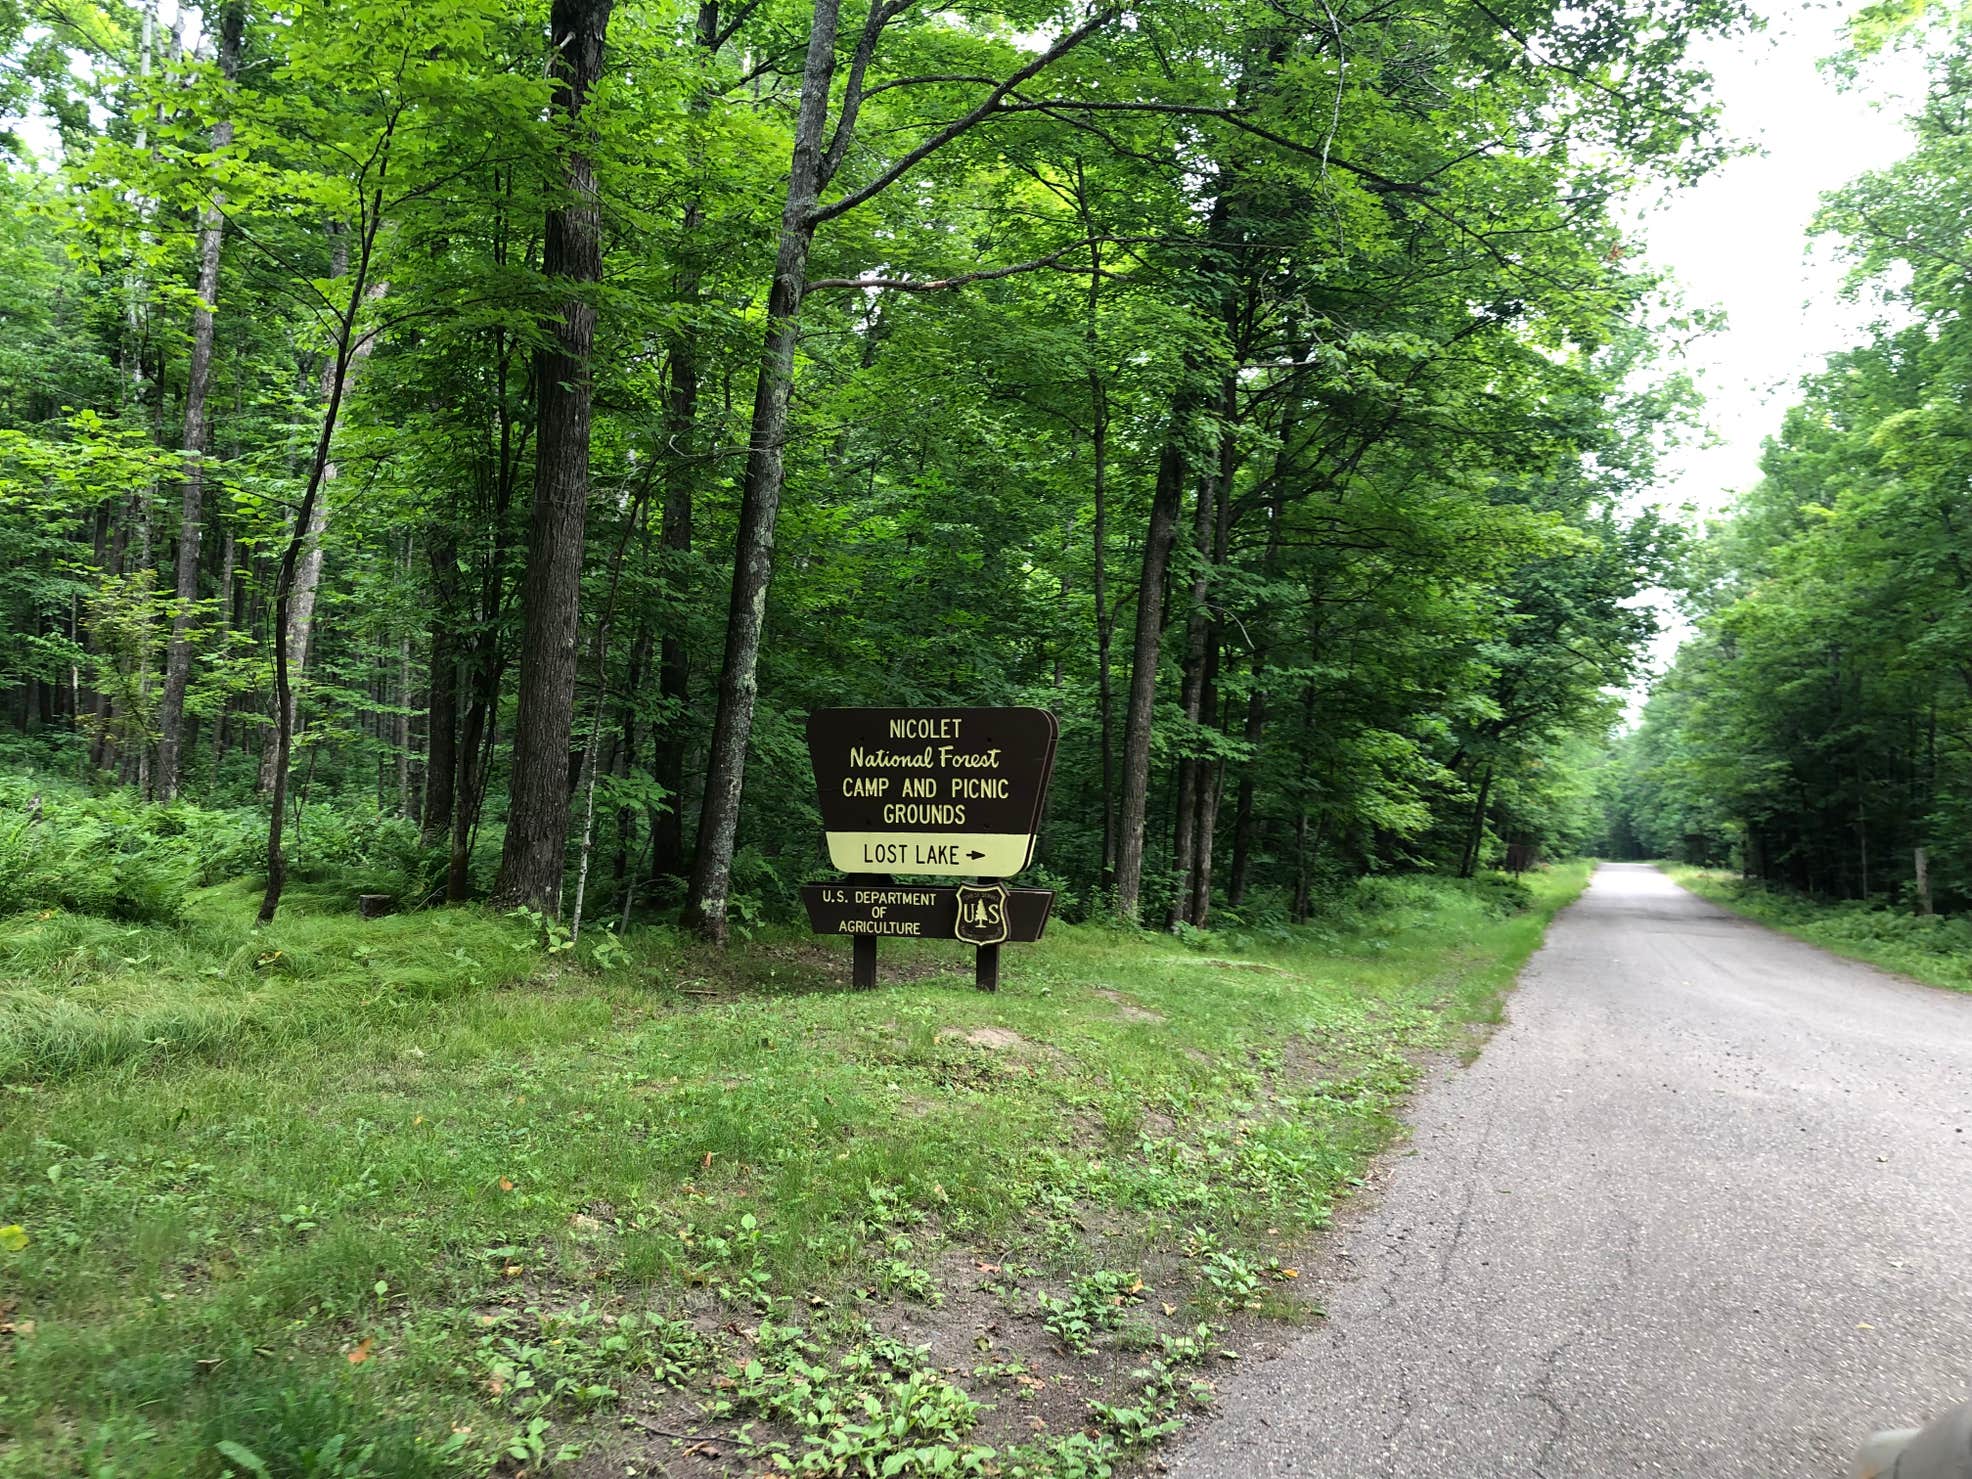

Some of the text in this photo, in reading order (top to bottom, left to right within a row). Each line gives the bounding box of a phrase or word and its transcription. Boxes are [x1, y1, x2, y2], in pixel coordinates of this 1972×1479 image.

[889, 718, 962, 739] NICOLET
[850, 746, 1002, 769] National Forest
[842, 777, 1009, 799] CAMP AND PICNIC
[883, 804, 966, 825] GROUNDS
[864, 843, 960, 865] LOST LAKE
[822, 889, 936, 906] U.S. DEPARTMENT
[871, 906, 887, 919] OF
[838, 920, 921, 935] AGRICULTURE
